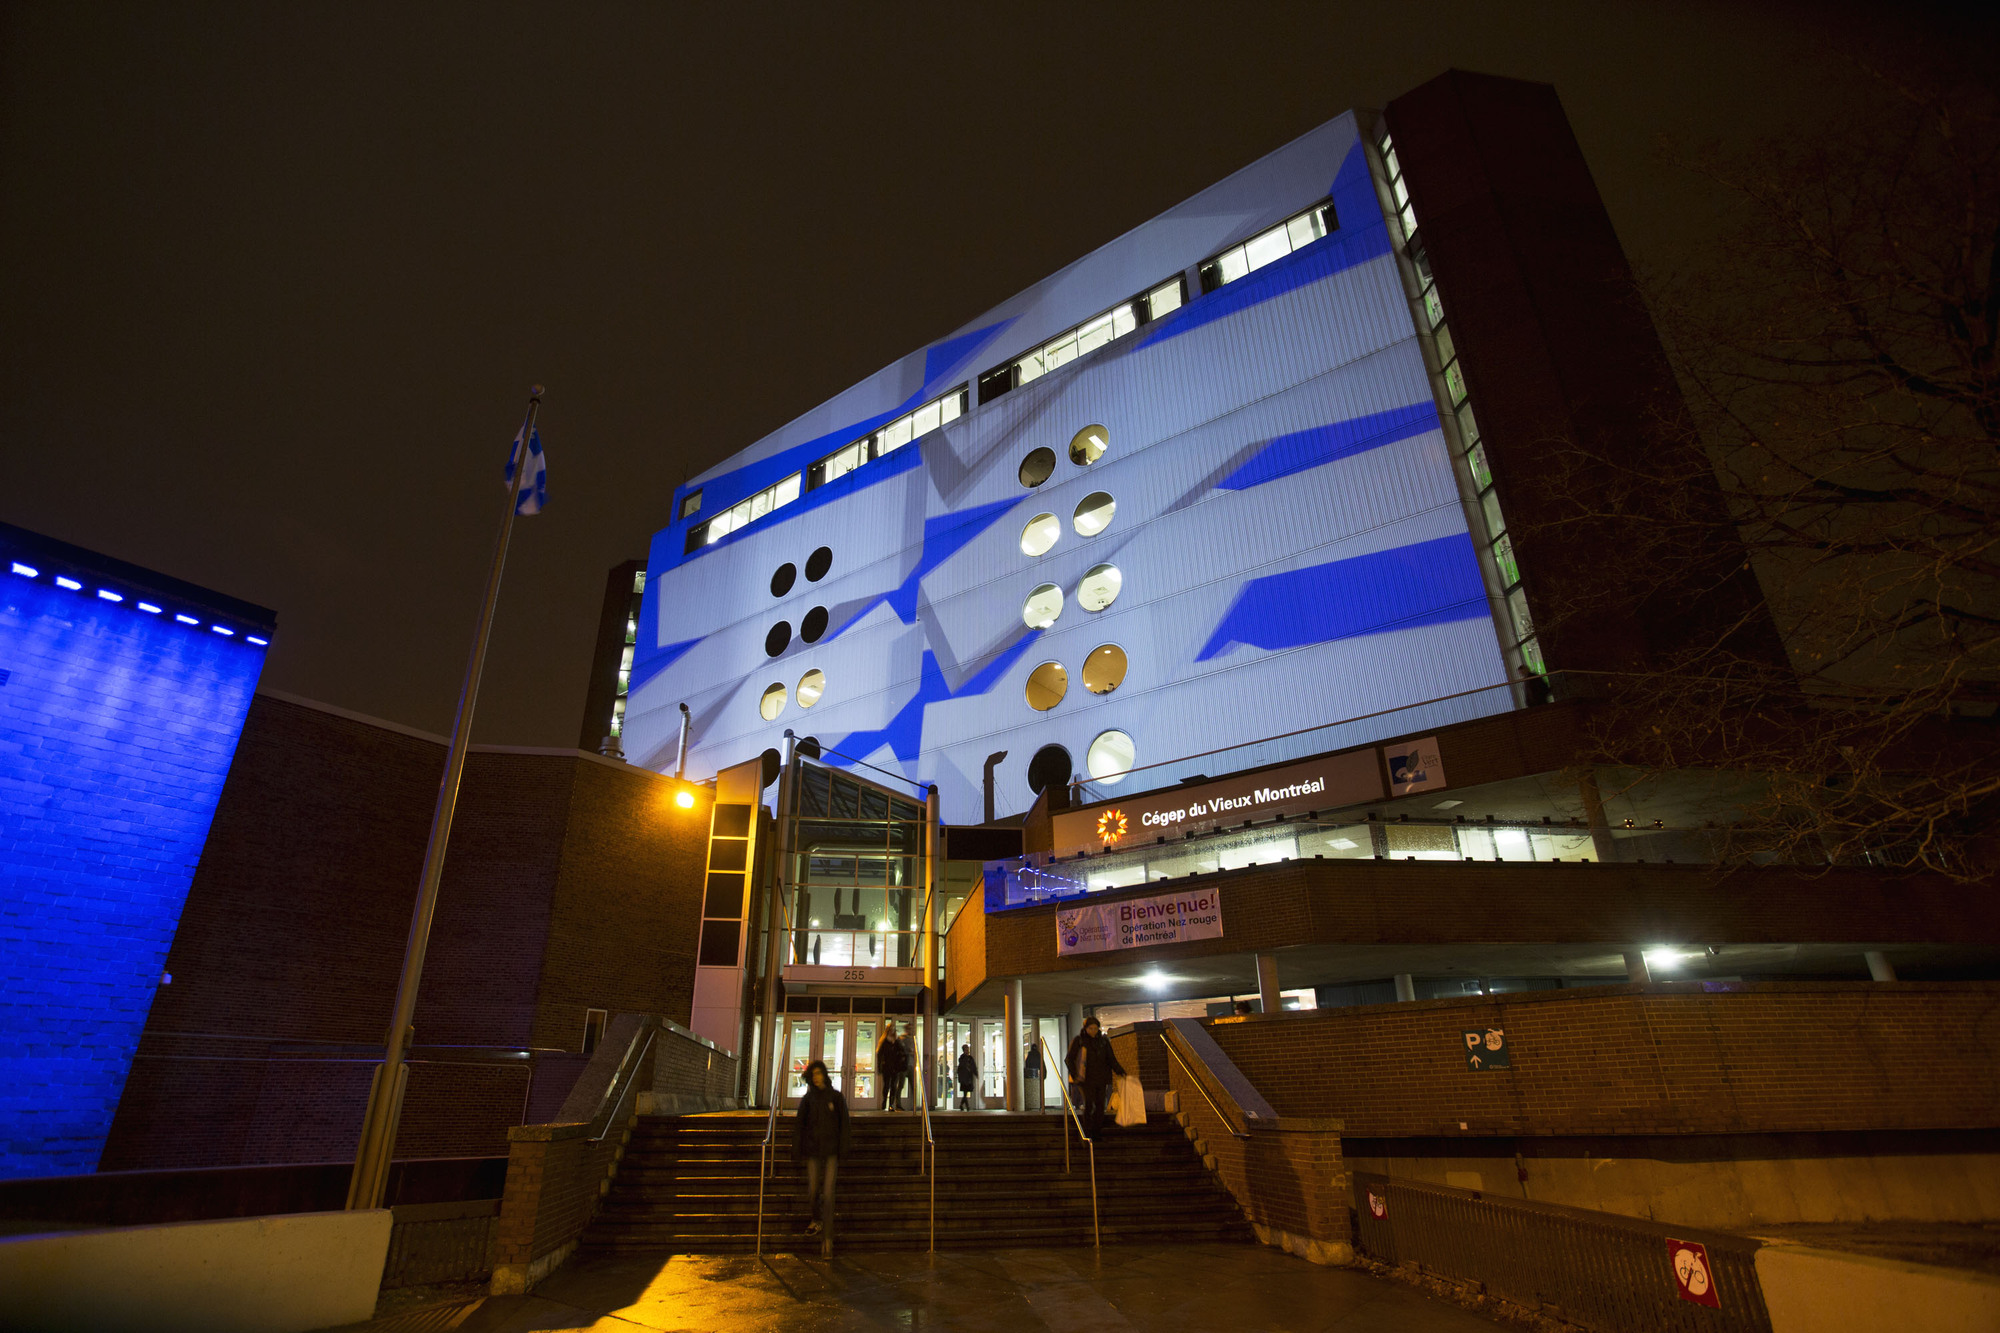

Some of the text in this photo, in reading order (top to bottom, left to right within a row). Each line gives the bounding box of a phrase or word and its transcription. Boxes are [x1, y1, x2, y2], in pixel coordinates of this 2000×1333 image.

[1142, 777, 1325, 827] Cégep du Vieux Montréal
[1120, 894, 1215, 921] Bienvenue!
[1121, 915, 1217, 934] Opération Nez rouge
[1122, 930, 1176, 945] de Montréal
[844, 970, 865, 980] 255
[1465, 1033, 1481, 1051] P
